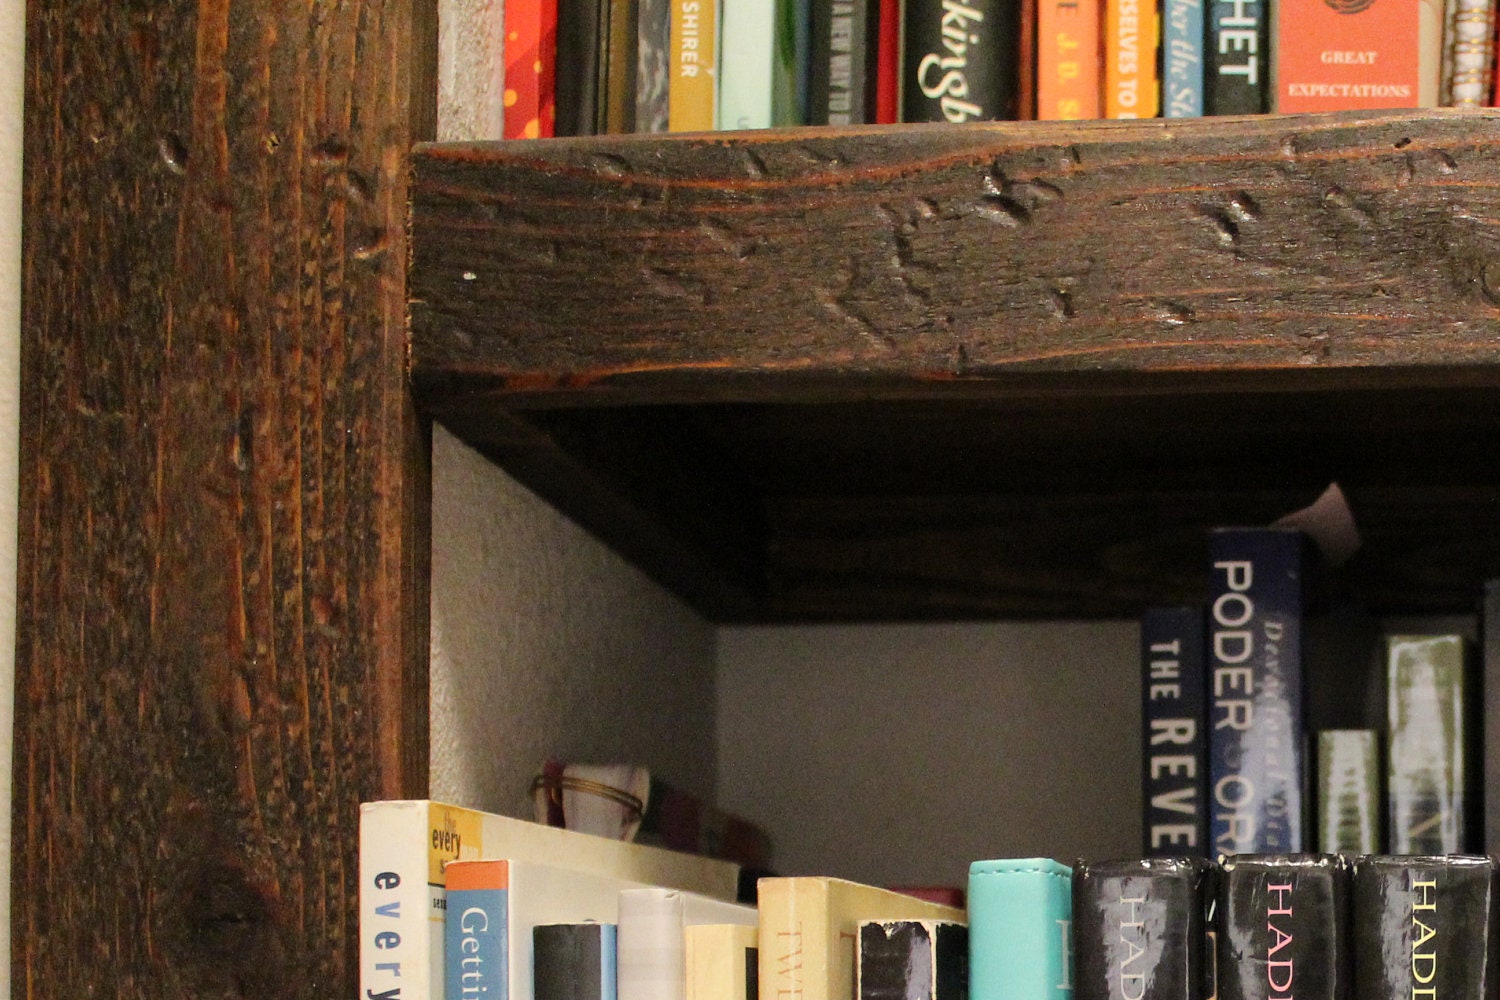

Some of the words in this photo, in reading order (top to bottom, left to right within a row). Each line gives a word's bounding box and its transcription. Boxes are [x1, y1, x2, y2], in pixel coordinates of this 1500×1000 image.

[681, 2, 699, 78] SHIRER
[917, 0, 984, 123] kingb
[1118, 0, 1139, 74] SELVES
[1170, 39, 1200, 80] the
[1320, 51, 1377, 65] GREAT
[1118, 78, 1139, 107] TO
[1288, 83, 1411, 98] EXPECTATIONS
[1150, 639, 1180, 700] THE
[1213, 560, 1253, 731] PODER
[1150, 718, 1197, 849] REVE
[1214, 775, 1255, 856] OR
[432, 829, 461, 860] every
